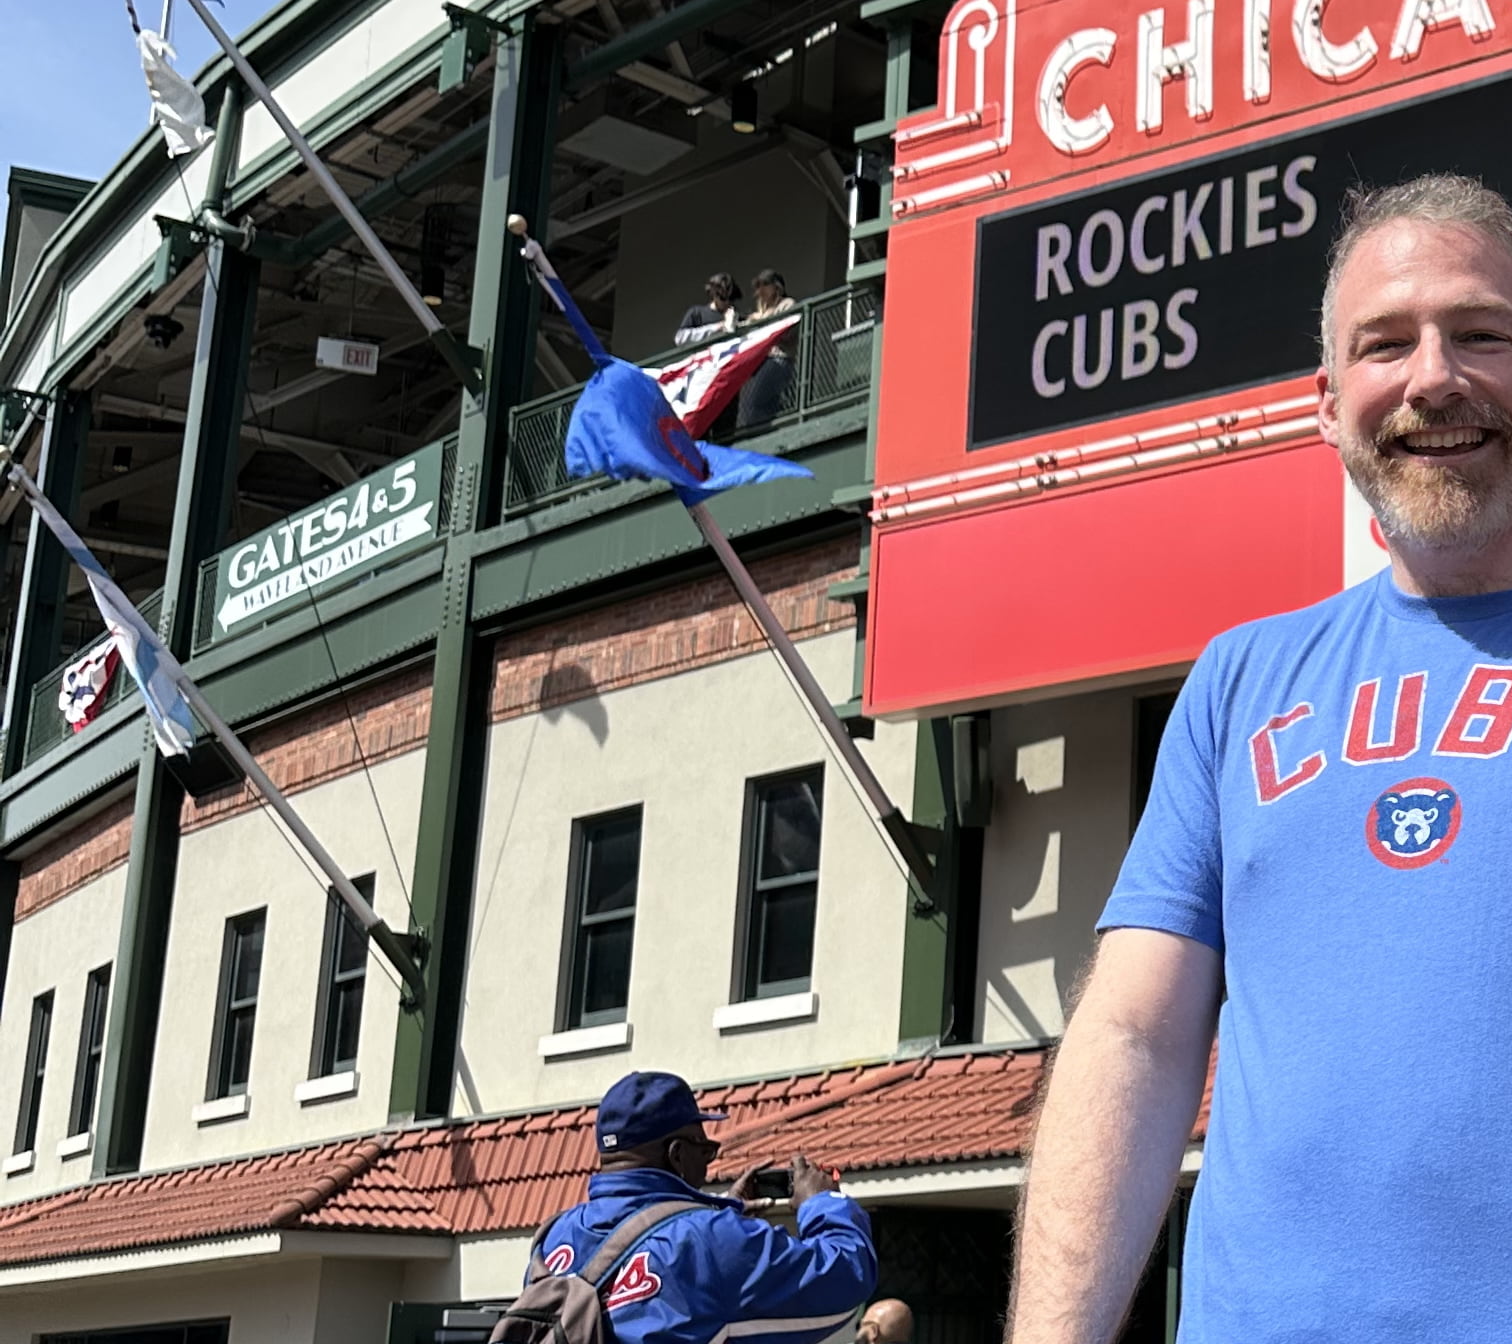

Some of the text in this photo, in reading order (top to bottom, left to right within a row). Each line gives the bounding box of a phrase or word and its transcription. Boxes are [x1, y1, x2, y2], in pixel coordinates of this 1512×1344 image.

[1035, 155, 1318, 302] ROCKIES
[1031, 288, 1199, 399] CUBS
[228, 497, 348, 589] GATES
[347, 483, 370, 529] 4
[389, 460, 416, 513] 5
